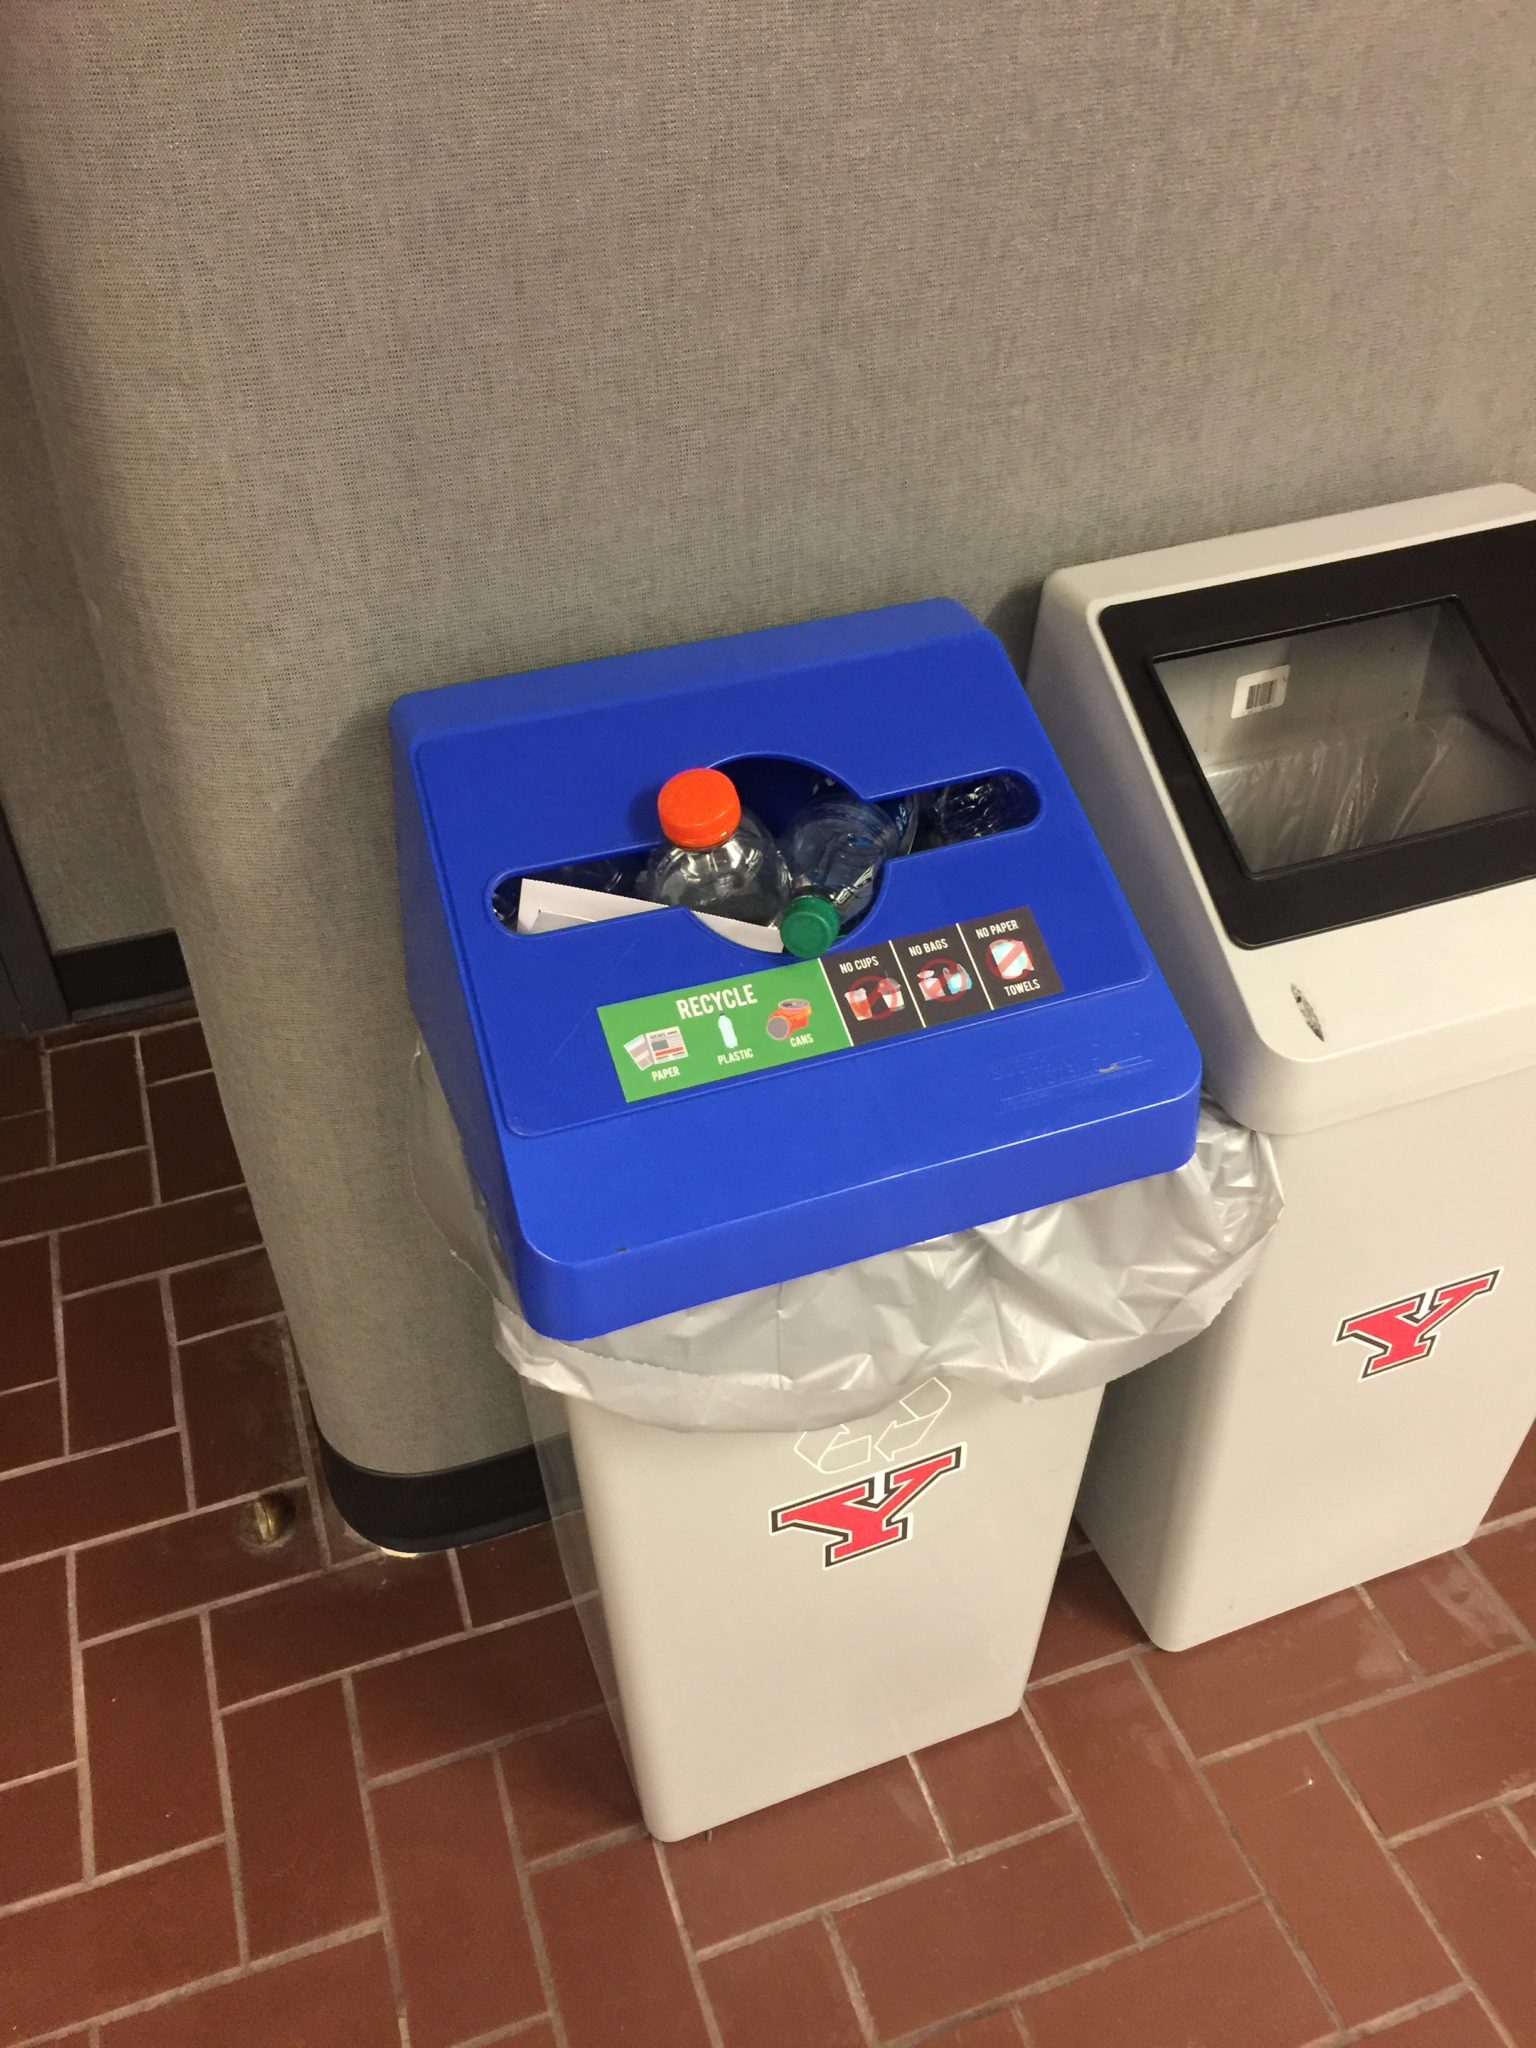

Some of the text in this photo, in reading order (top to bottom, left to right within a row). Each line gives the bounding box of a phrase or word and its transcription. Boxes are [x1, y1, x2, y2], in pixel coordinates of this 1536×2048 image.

[975, 919, 1019, 940] NO PAPER
[908, 938, 949, 957] NO BAGS
[839, 956, 880, 974] NO CUPS
[1003, 978, 1040, 997] TOWELS
[675, 984, 758, 1020] RECYCLE
[789, 1033, 814, 1048] CANS
[717, 1048, 754, 1065] PLASTIC
[651, 1066, 681, 1082] PAPER
[1332, 1265, 1504, 1383] Y
[768, 1441, 967, 1571] Y
